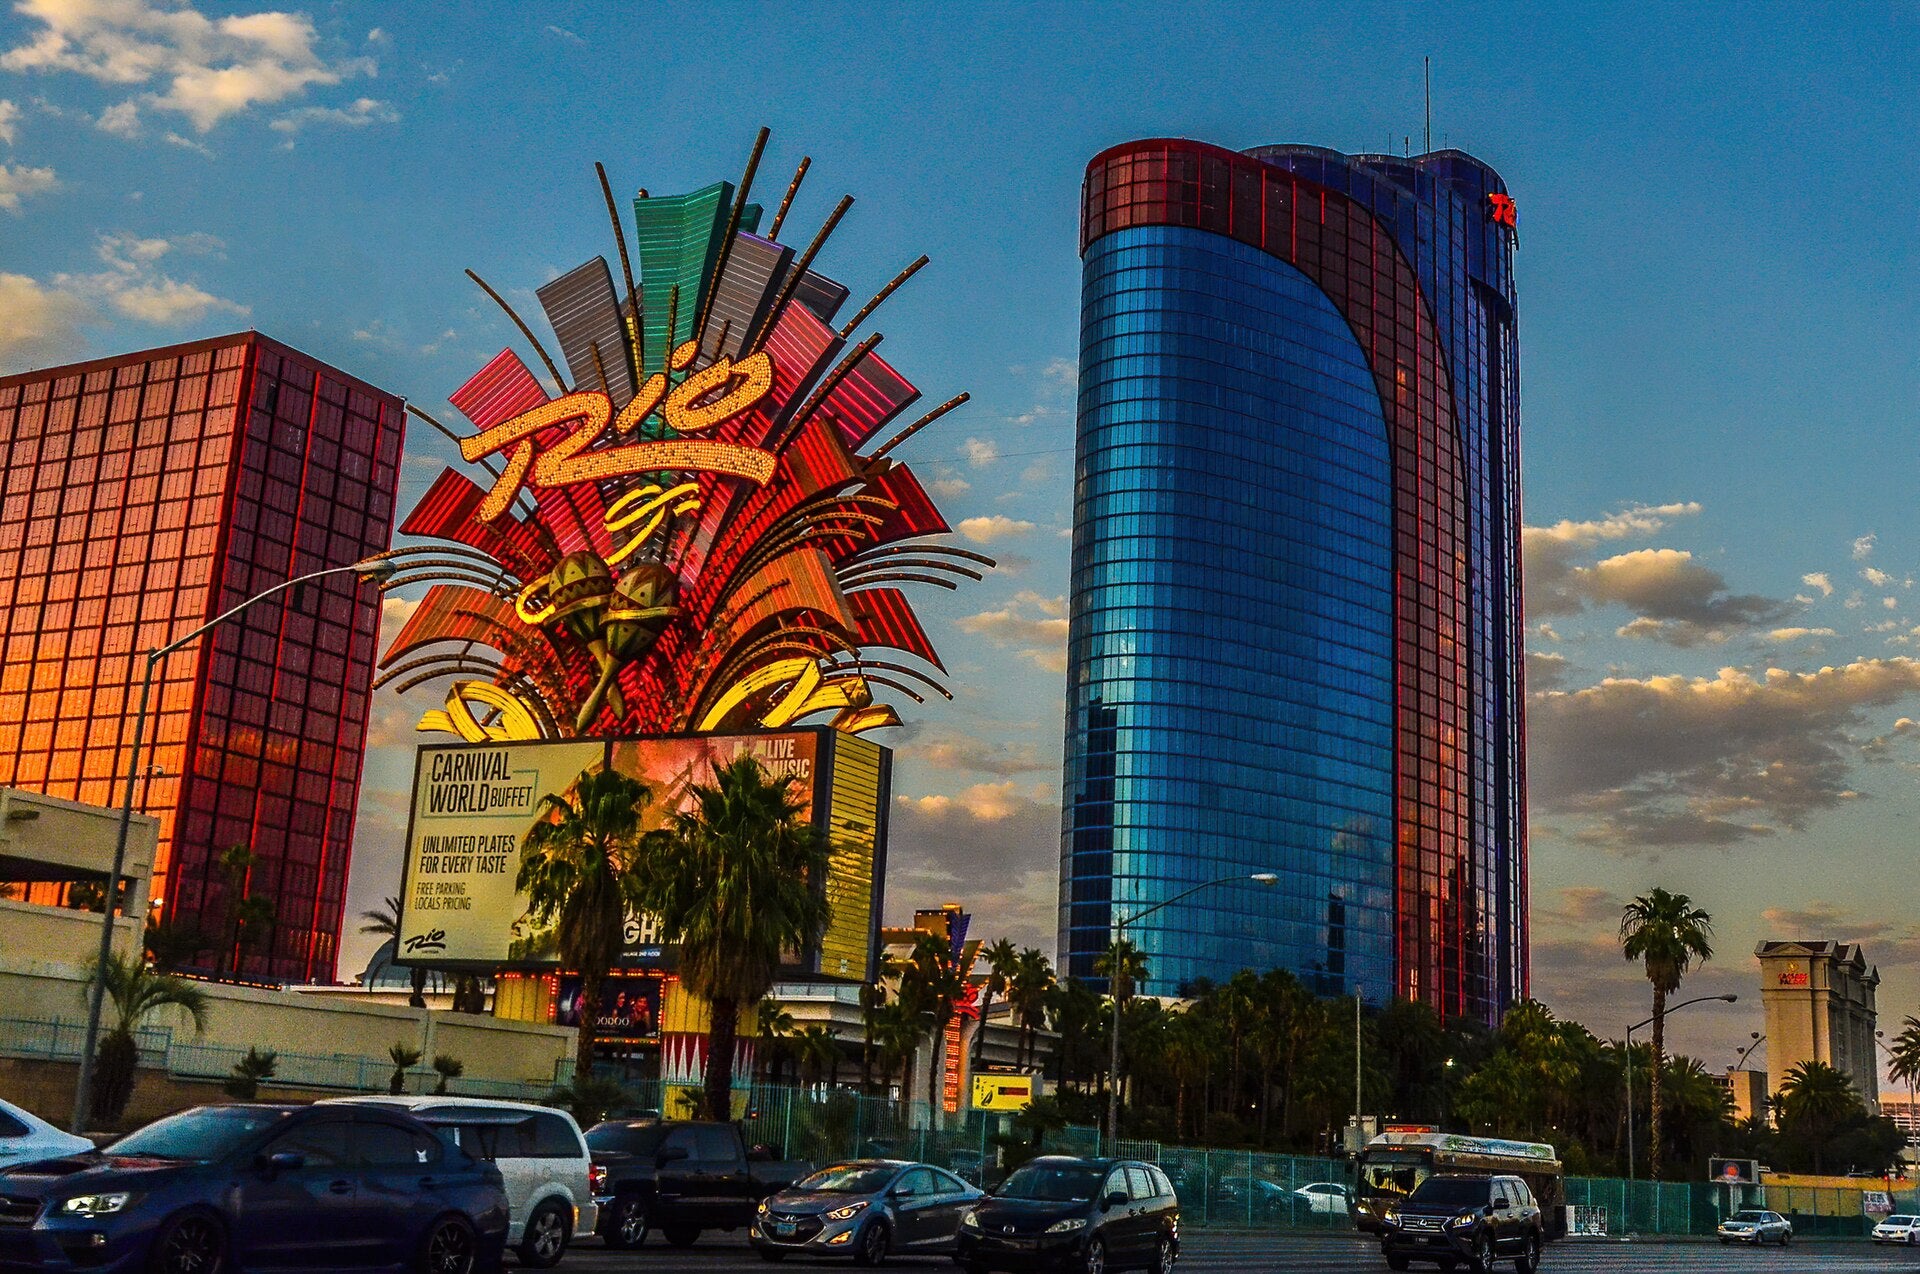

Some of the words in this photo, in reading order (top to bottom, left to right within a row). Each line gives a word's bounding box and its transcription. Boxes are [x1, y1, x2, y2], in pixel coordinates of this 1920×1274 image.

[459, 339, 777, 524] Rio
[767, 738, 795, 759] LIVE
[431, 752, 511, 782] CARNIVAL
[430, 784, 489, 813] WORLD
[490, 786, 532, 807] BUFFET
[422, 835, 476, 853] UNLIMITED
[477, 835, 515, 853] PLATES
[419, 856, 440, 874] FOR
[441, 856, 473, 873] EVERY
[476, 856, 507, 873] TASTE
[416, 882, 433, 895] FREE
[435, 882, 466, 896] PARKING
[415, 897, 441, 910] LOCALS
[442, 897, 472, 910] PRICING
[404, 928, 446, 953] Rio
